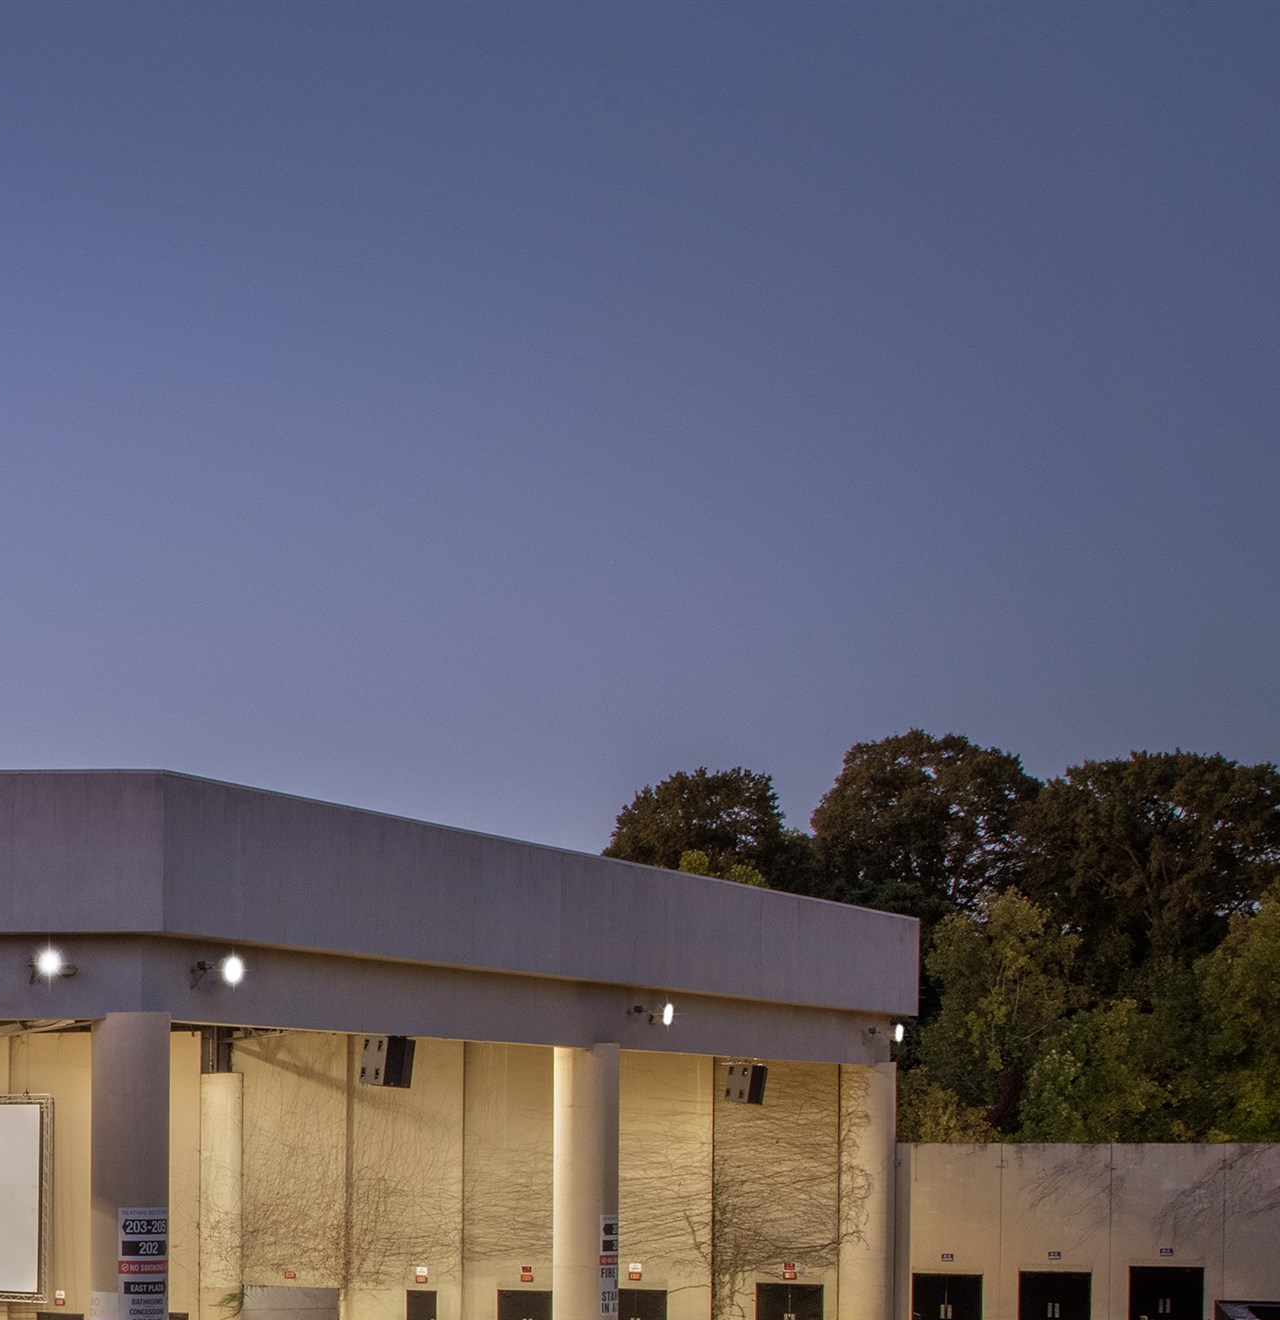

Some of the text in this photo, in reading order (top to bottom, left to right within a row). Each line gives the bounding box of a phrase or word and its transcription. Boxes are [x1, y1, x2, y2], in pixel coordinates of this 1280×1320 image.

[139, 1241, 159, 1254] 202
[129, 1263, 139, 1272] NO
[601, 1268, 616, 1278] FIRE
[130, 1284, 147, 1292] EAST
[601, 1303, 609, 1314] IN
